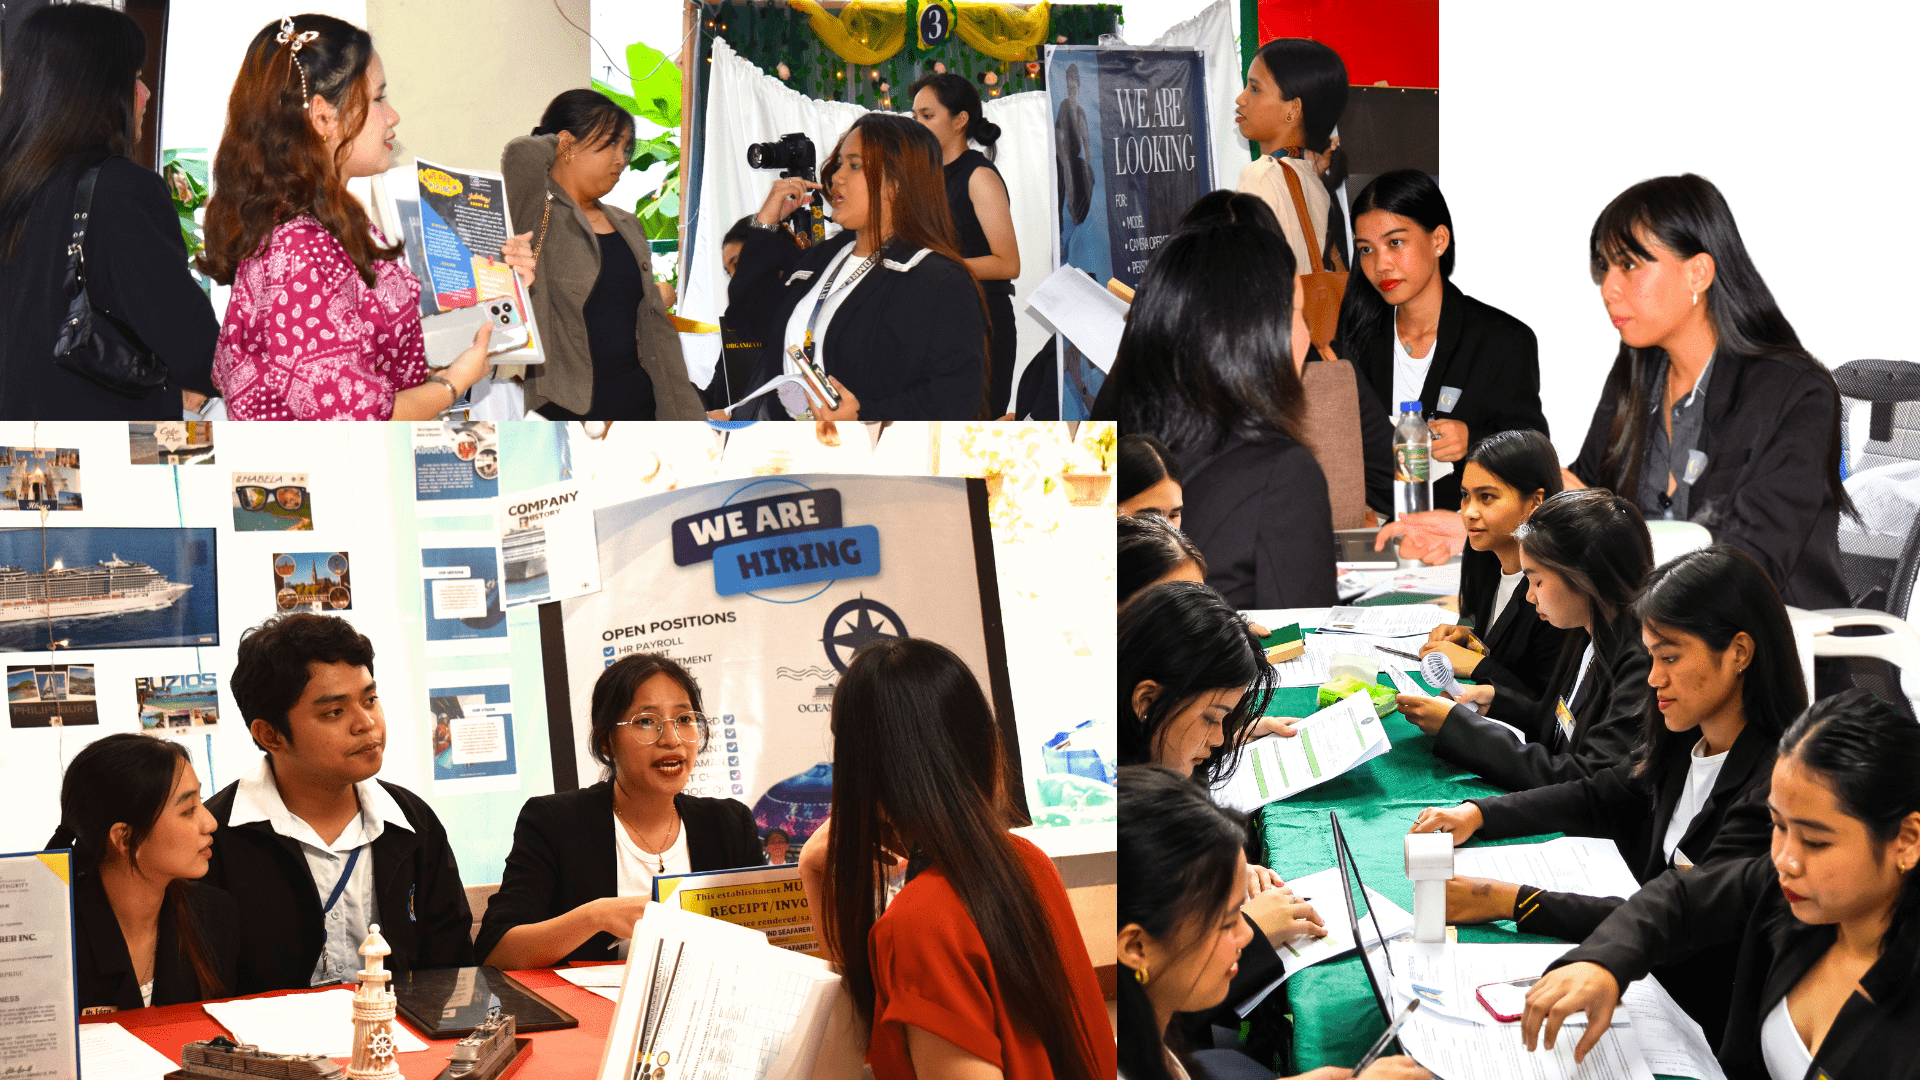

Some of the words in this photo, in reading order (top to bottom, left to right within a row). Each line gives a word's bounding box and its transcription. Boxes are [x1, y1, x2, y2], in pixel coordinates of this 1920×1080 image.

[929, 9, 942, 39] 3
[1114, 88, 1150, 129] WE
[1151, 88, 1185, 128] ARE
[1113, 133, 1196, 176] LOOKING
[1126, 215, 1145, 229] MODEL
[1129, 237, 1149, 252] CAMERA
[235, 475, 283, 484] ILHABELA
[508, 490, 579, 516] COMPANY
[527, 508, 561, 522] HISTORY
[688, 511, 748, 546] WE
[756, 498, 820, 533] ARE
[737, 538, 862, 580] HIRING
[602, 624, 646, 642] OPEN
[650, 611, 737, 633] POSITIONS
[618, 645, 633, 655] HR
[636, 637, 684, 652] PAYROLL
[136, 672, 217, 691] BUZIOS
[13, 704, 94, 716] PHILIPSBURG
[694, 758, 725, 768] AMAN
[696, 893, 715, 901] This
[717, 886, 781, 899] establishment
[18, 933, 38, 942] INC.
[777, 926, 811, 937] SEAFARER
[780, 943, 813, 952] EAFARER
